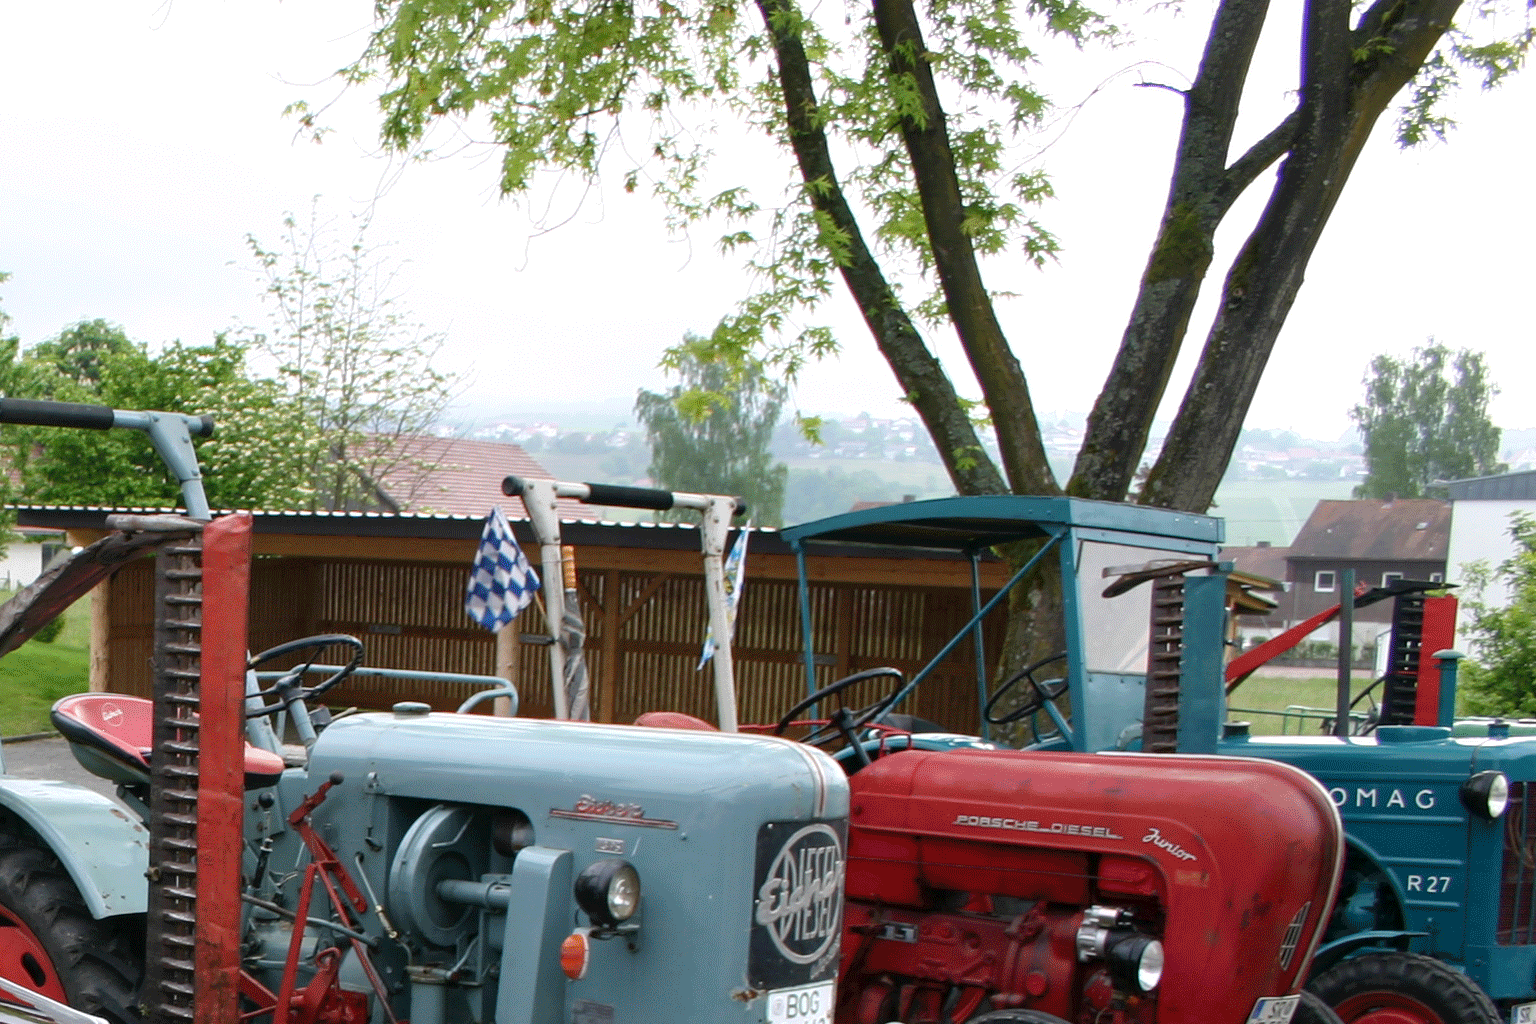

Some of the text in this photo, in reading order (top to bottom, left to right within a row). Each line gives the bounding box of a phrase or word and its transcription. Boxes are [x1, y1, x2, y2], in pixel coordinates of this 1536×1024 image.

[953, 815, 1124, 840] PORSCHE DIESEL
[1142, 827, 1197, 861] Junior
[1408, 875, 1451, 893] R 27
[786, 990, 820, 1019] BOG
